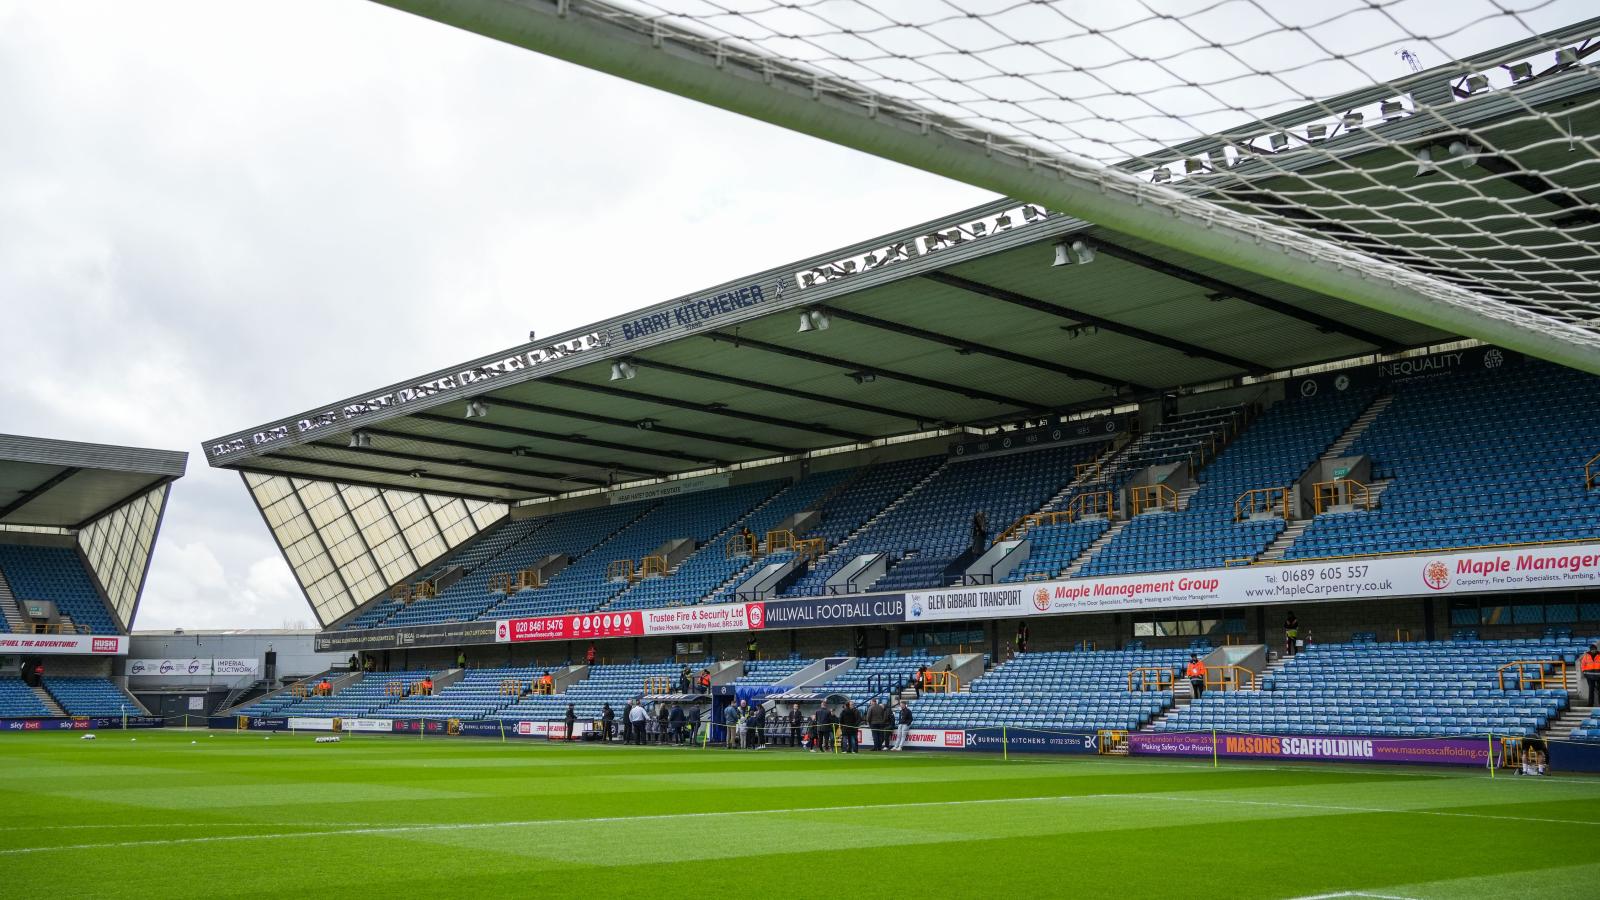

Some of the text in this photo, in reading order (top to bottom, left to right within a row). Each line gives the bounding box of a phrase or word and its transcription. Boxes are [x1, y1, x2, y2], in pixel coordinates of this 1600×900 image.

[622, 285, 764, 340] BARRY KITCHENER
[1378, 352, 1463, 377] INEQUALITY
[1282, 569, 1315, 582] 01689
[1320, 567, 1342, 580] 605
[1348, 566, 1368, 578] 557
[1456, 556, 1510, 576] Maple
[1055, 577, 1219, 600] Maple Management Group
[1246, 580, 1392, 597] www.MapleCarpentry.co.uk
[929, 595, 945, 610] GLEN
[948, 593, 977, 608] GIBBARD
[979, 590, 1022, 607] TRANSPORT
[650, 608, 744, 622] Trustee Fire & Security Ltd
[766, 601, 903, 621] MILLWALL FOOTBALL CLUB
[516, 619, 563, 632] 020 8461 5476
[25, 720, 39, 729] bet
[74, 720, 88, 728] bet
[1192, 744, 1214, 752] Priority
[1226, 737, 1373, 757] MASONS SCAFFOLDING
